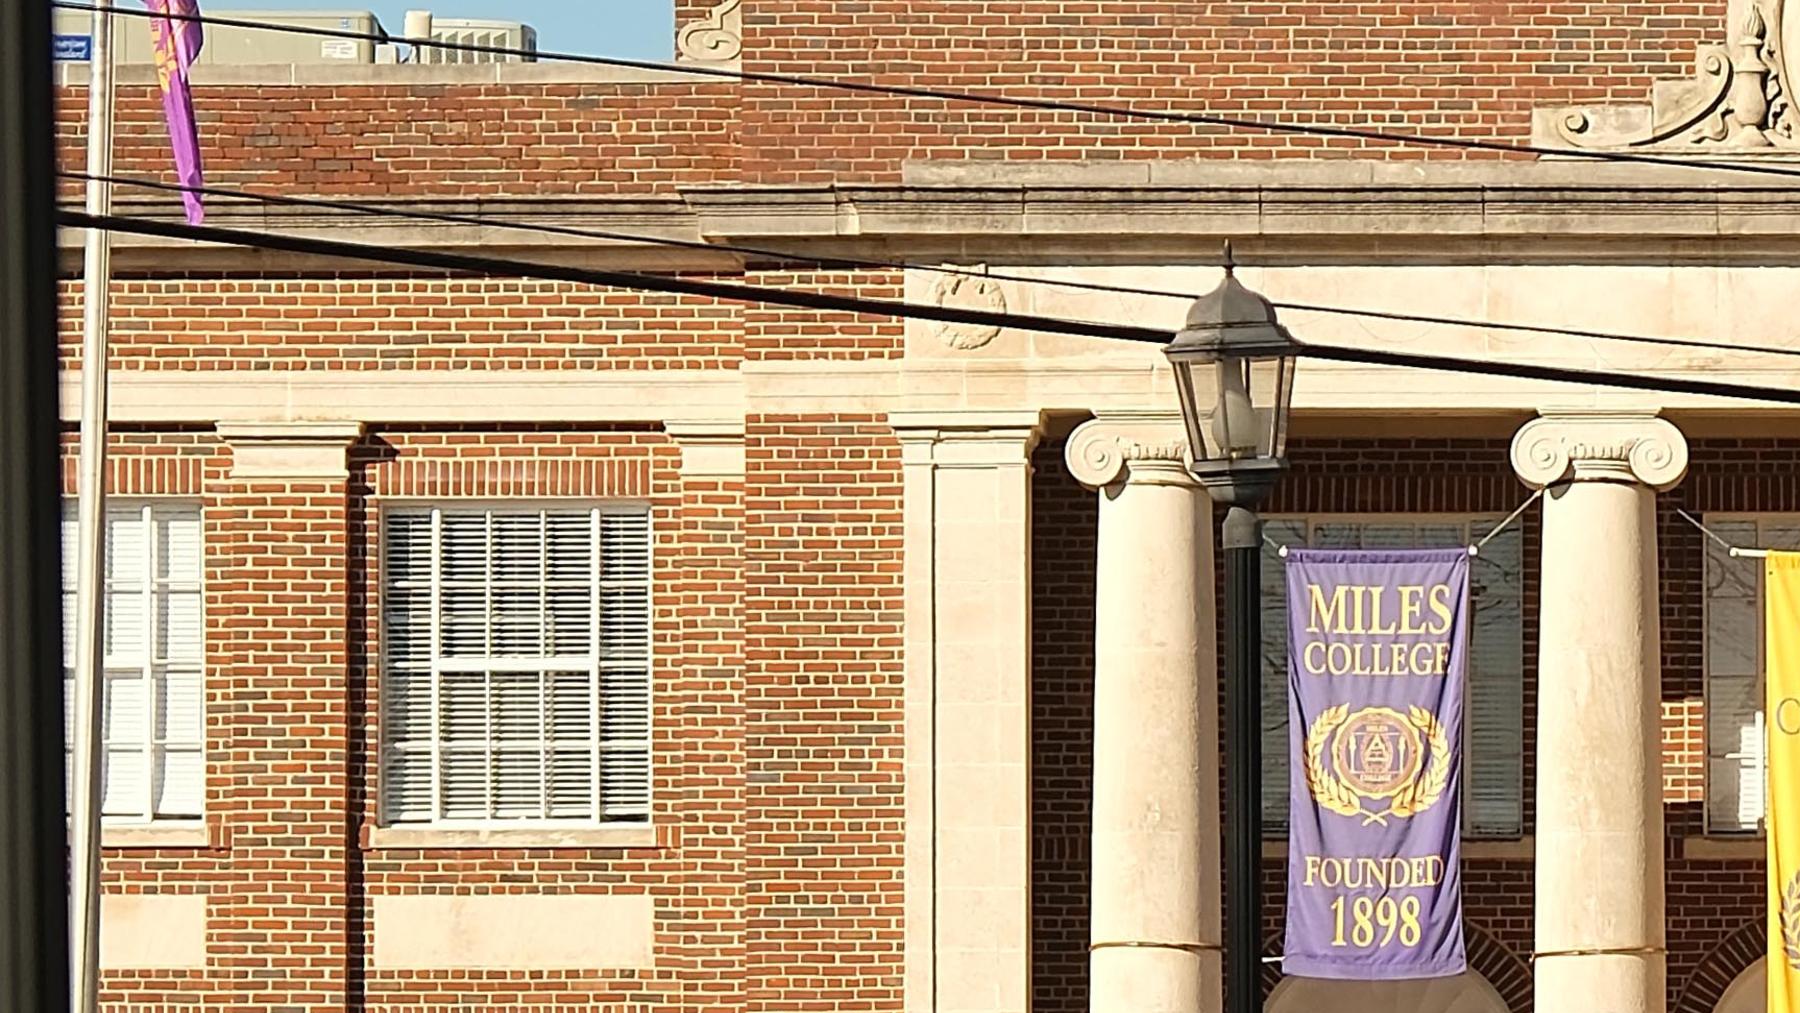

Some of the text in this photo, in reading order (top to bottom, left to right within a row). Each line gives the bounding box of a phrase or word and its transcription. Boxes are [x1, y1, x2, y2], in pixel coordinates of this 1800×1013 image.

[1305, 584, 1452, 634] MILES
[1304, 641, 1450, 675] COLLEGE
[1303, 855, 1444, 889] FOUNDED
[1331, 895, 1422, 948] 1898
